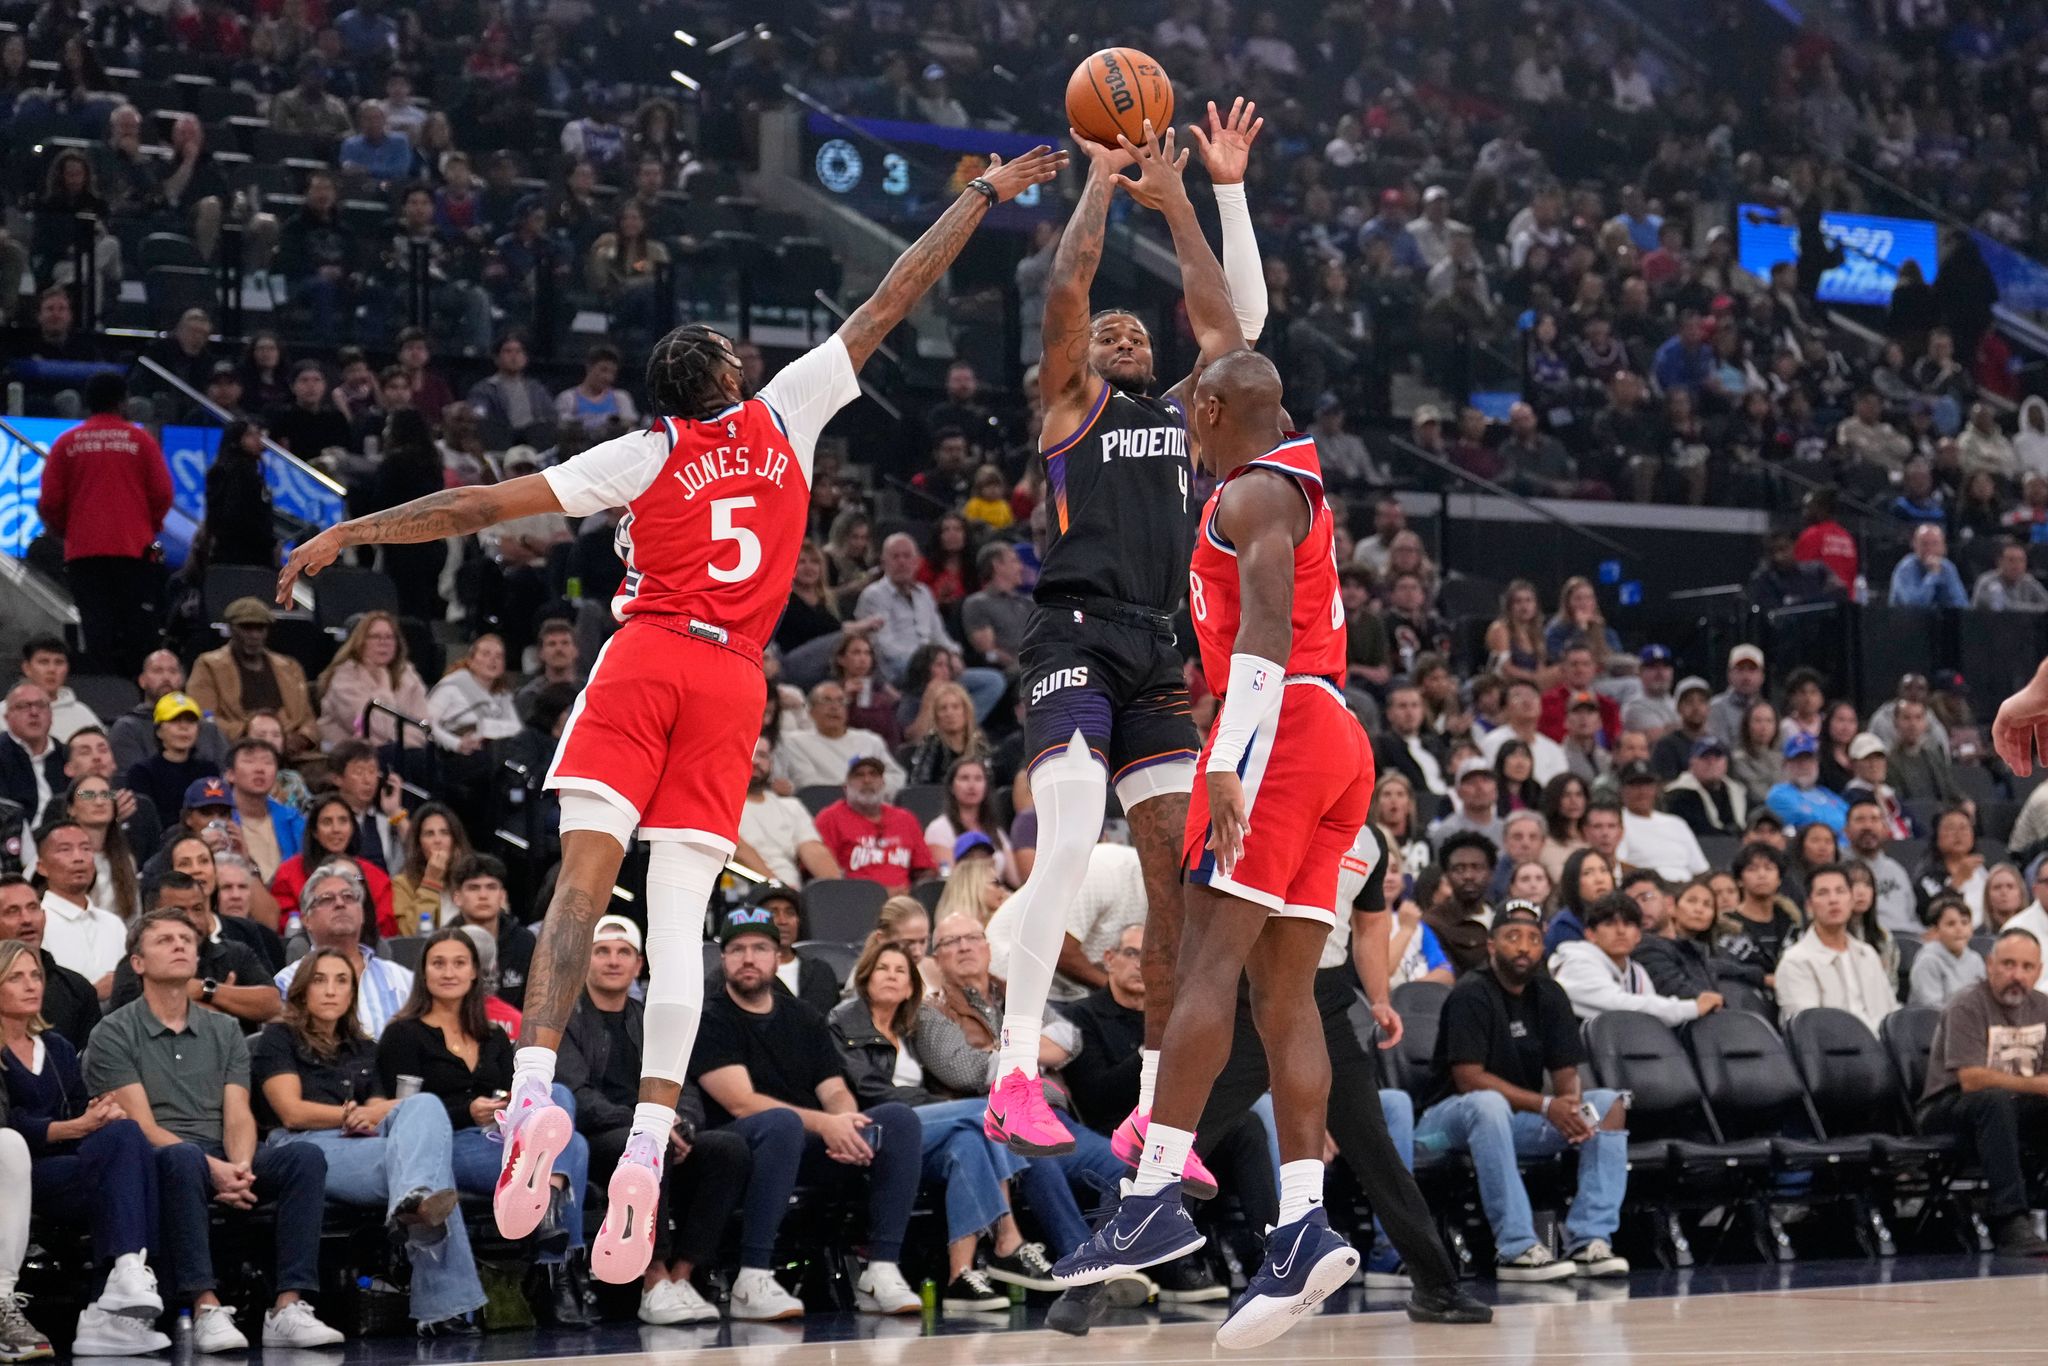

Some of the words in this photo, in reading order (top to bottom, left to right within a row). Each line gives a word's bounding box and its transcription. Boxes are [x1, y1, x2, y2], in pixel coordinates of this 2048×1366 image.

[1102, 52, 1134, 115] Wilson
[882, 153, 910, 195] 3
[1100, 427, 1187, 463] PHOENIX
[674, 447, 749, 501] JONES
[755, 447, 790, 489] JR.
[1177, 465, 1188, 514] 4
[707, 496, 762, 583] 5
[1190, 571, 1207, 621] 8
[1032, 666, 1088, 705] SUNS
